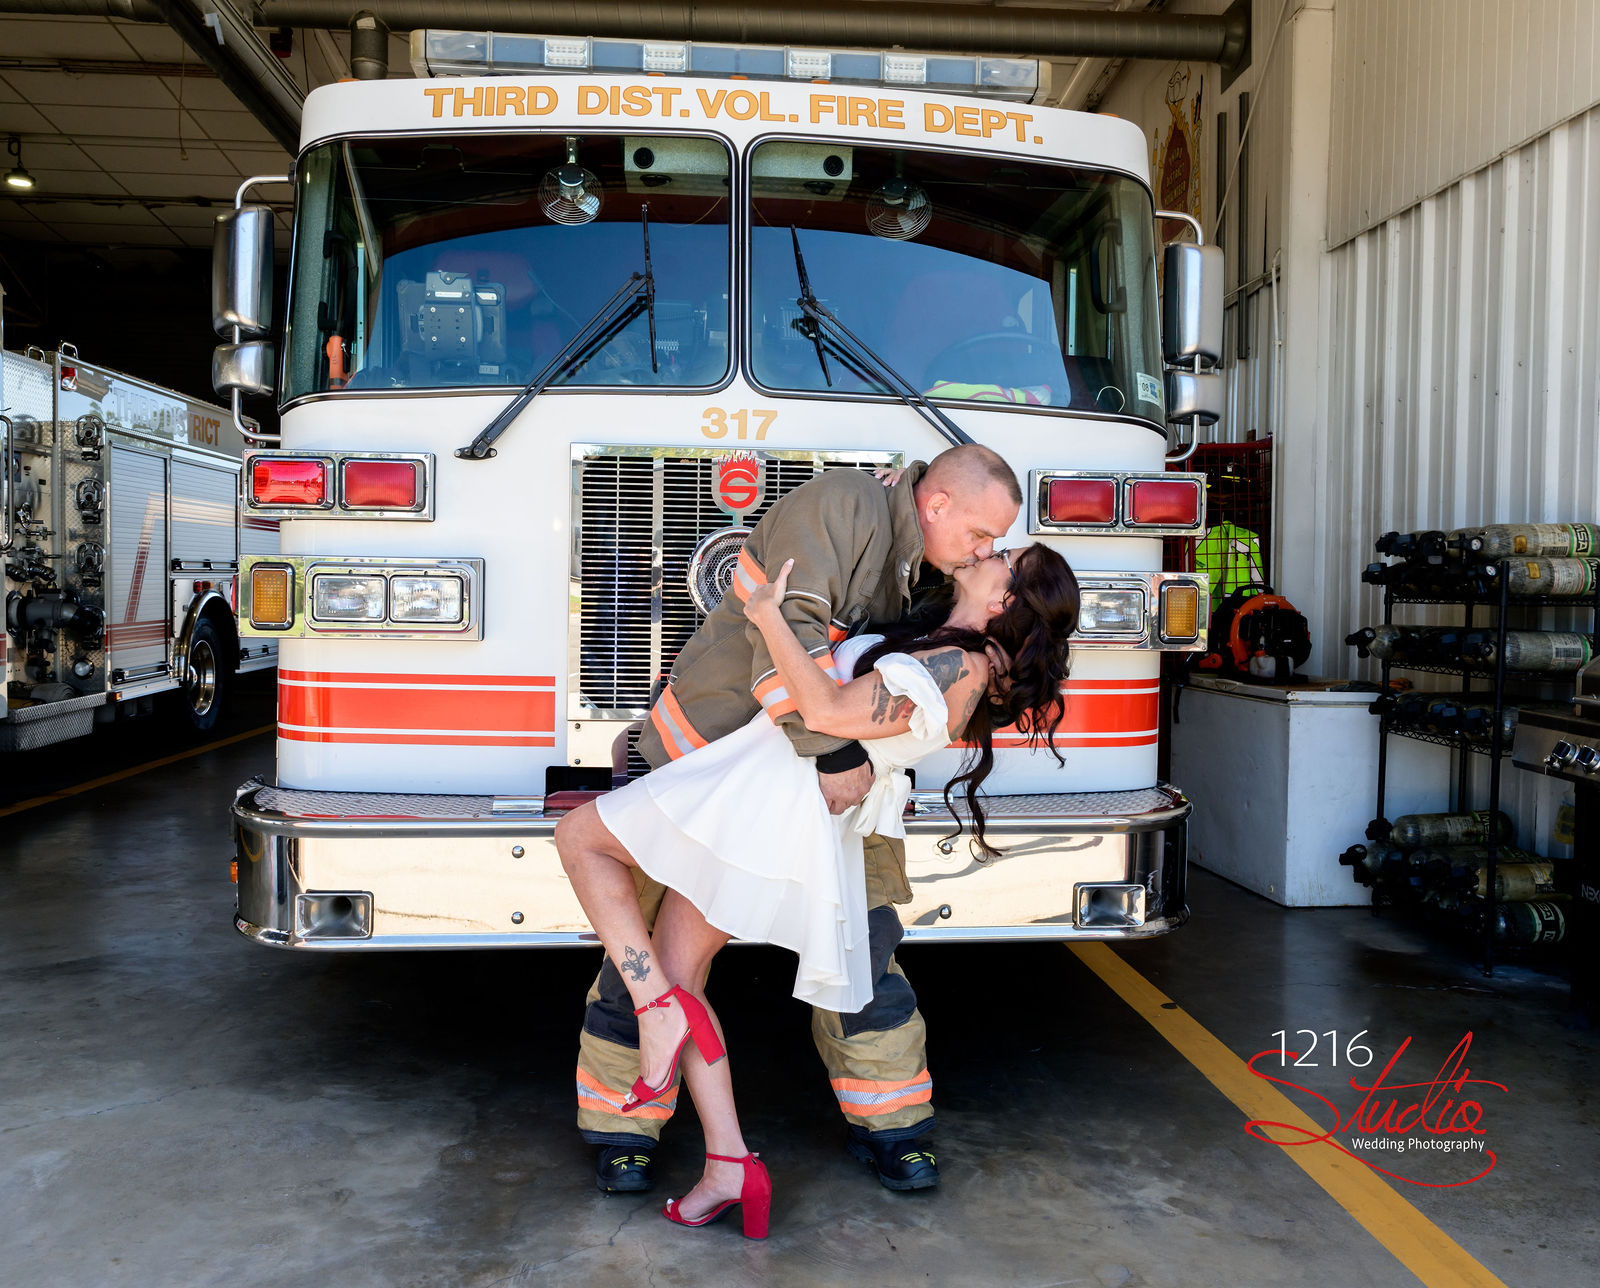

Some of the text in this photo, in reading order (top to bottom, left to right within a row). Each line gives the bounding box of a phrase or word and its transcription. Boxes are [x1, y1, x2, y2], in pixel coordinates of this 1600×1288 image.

[424, 85, 1044, 144] THIRD DIST. VOL. FIRE DEPT.
[701, 406, 778, 441] 317
[1574, 525, 1589, 552] MSA
[1581, 883, 1600, 905] NEX
